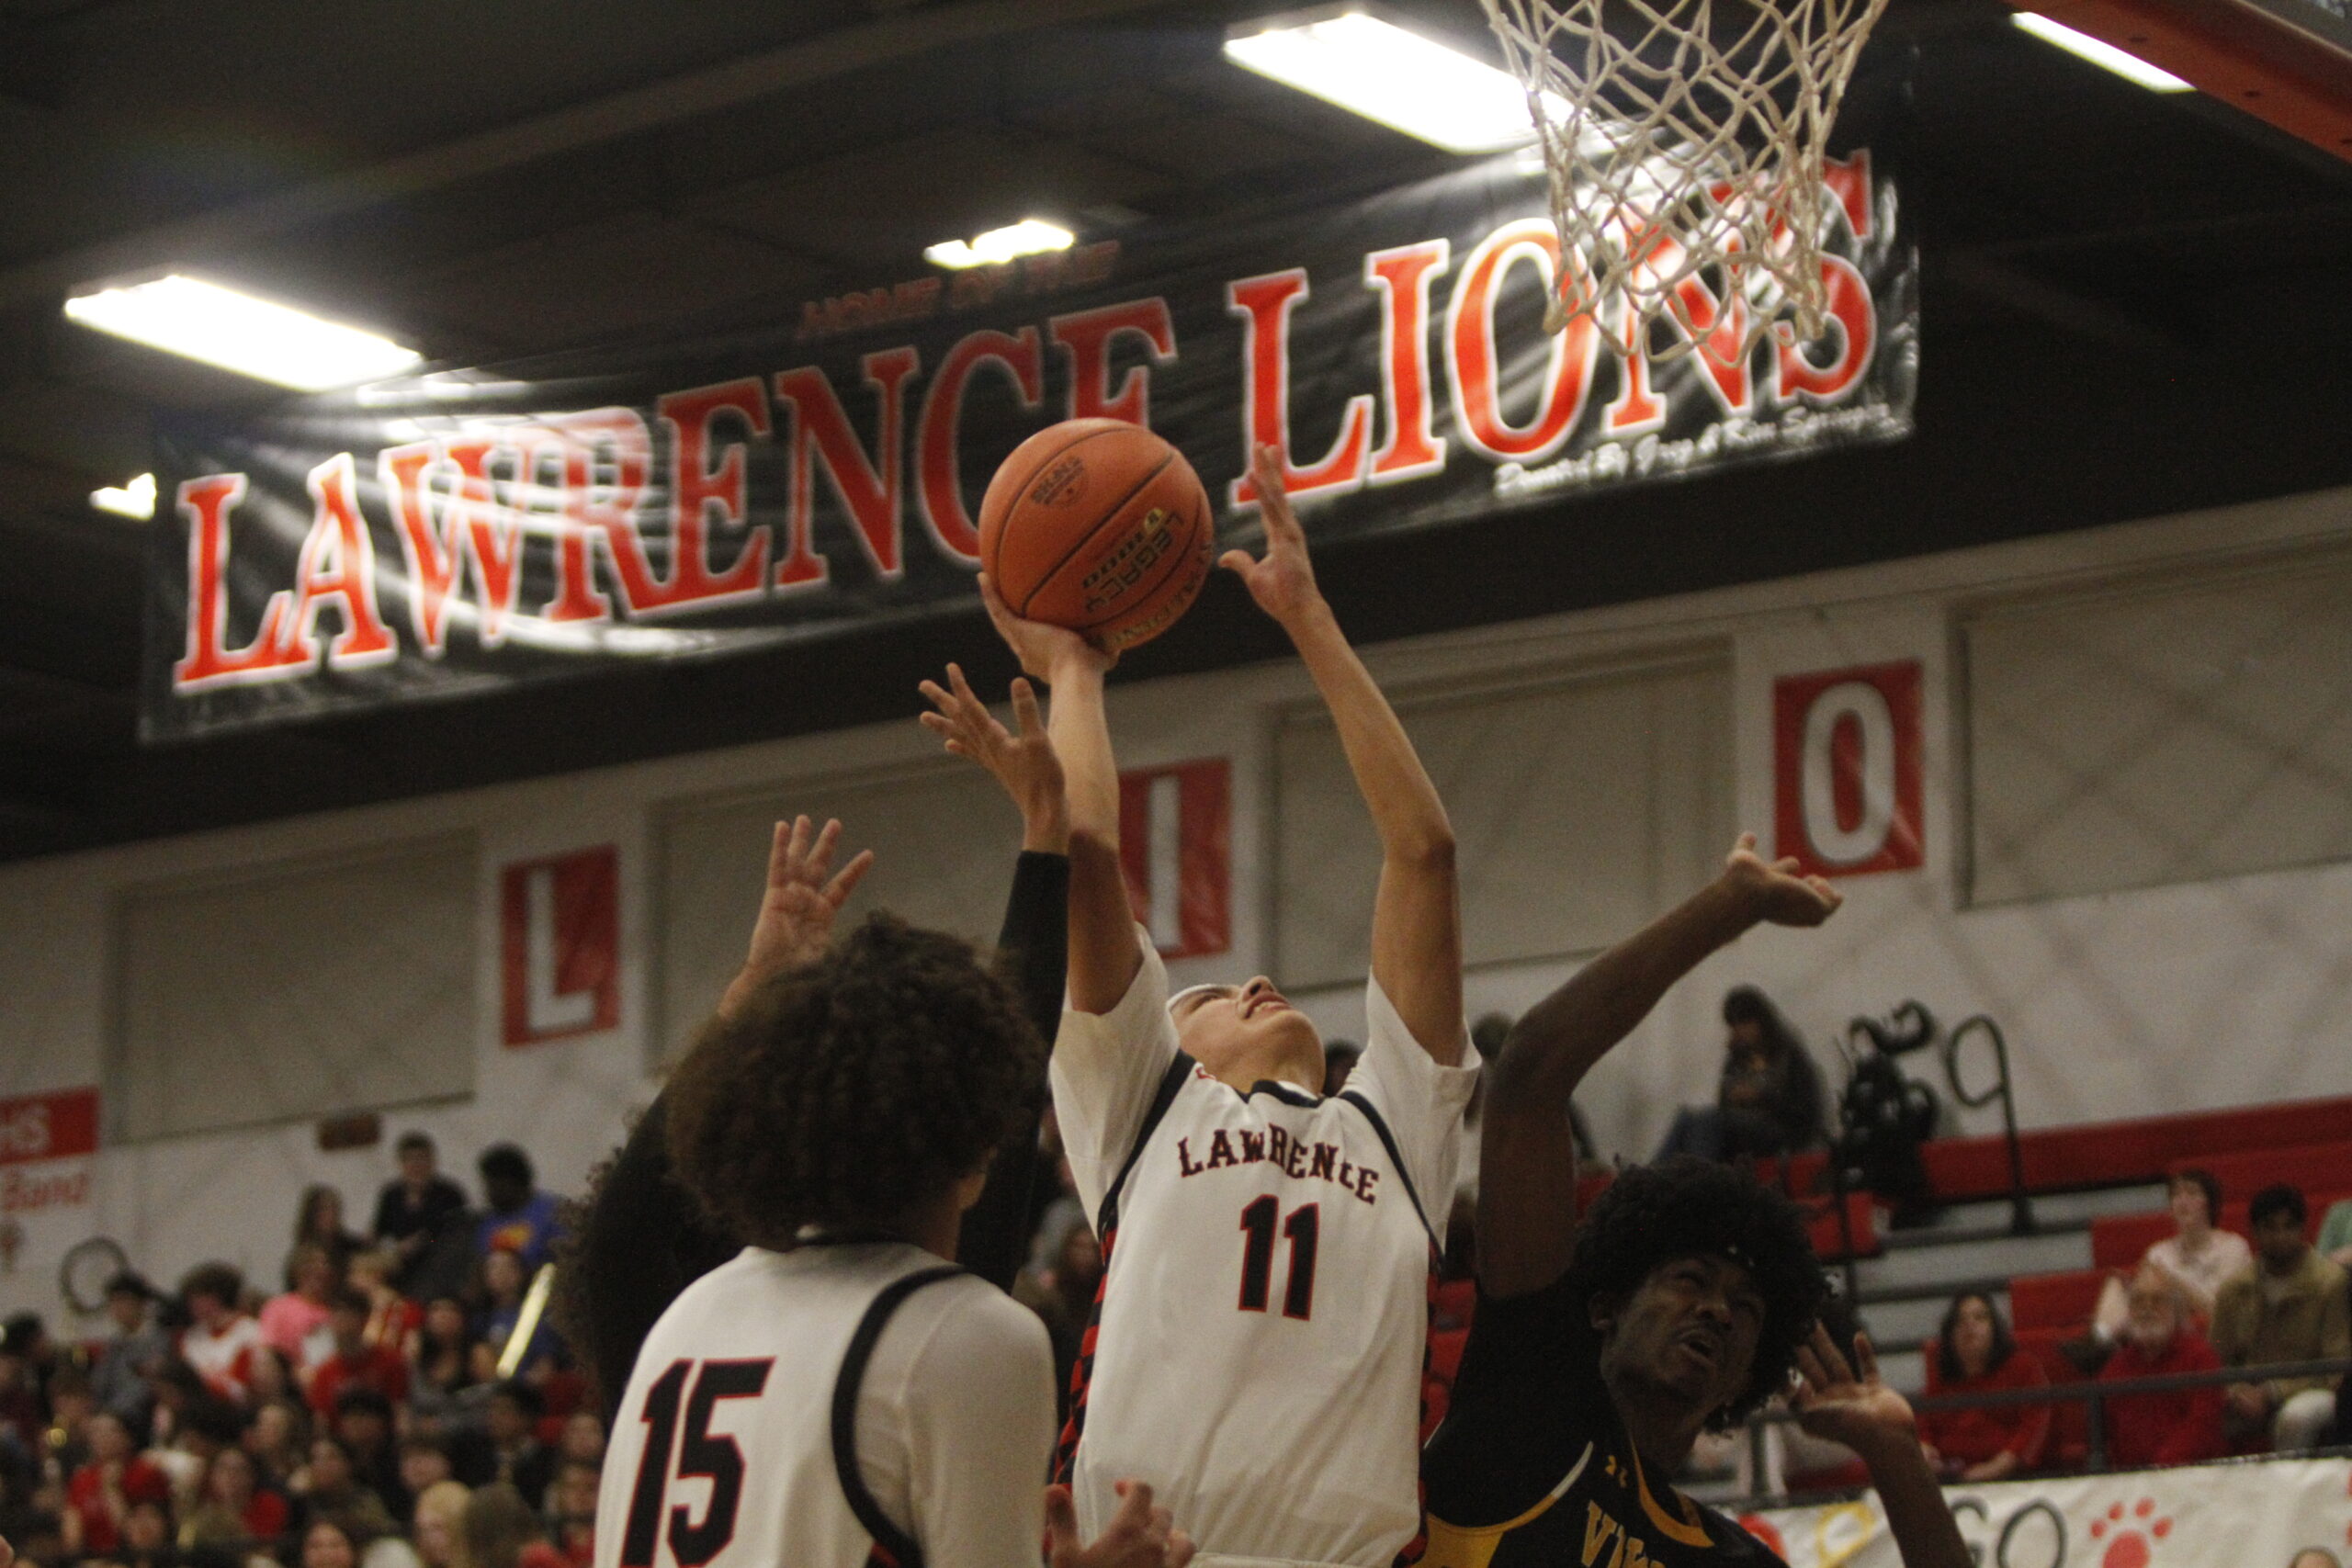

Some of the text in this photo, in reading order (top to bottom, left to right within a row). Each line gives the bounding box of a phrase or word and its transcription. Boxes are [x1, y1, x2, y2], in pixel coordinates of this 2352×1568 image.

[174, 148, 1877, 695] LAWRENCE LIONS
[1084, 510, 1185, 615] LEGACY
[526, 866, 596, 1032] L
[1801, 681, 1895, 864] O
[1177, 1122, 1379, 1205] LAWRENCE
[1238, 1193, 1319, 1322] 11
[618, 1355, 777, 1568] 15
